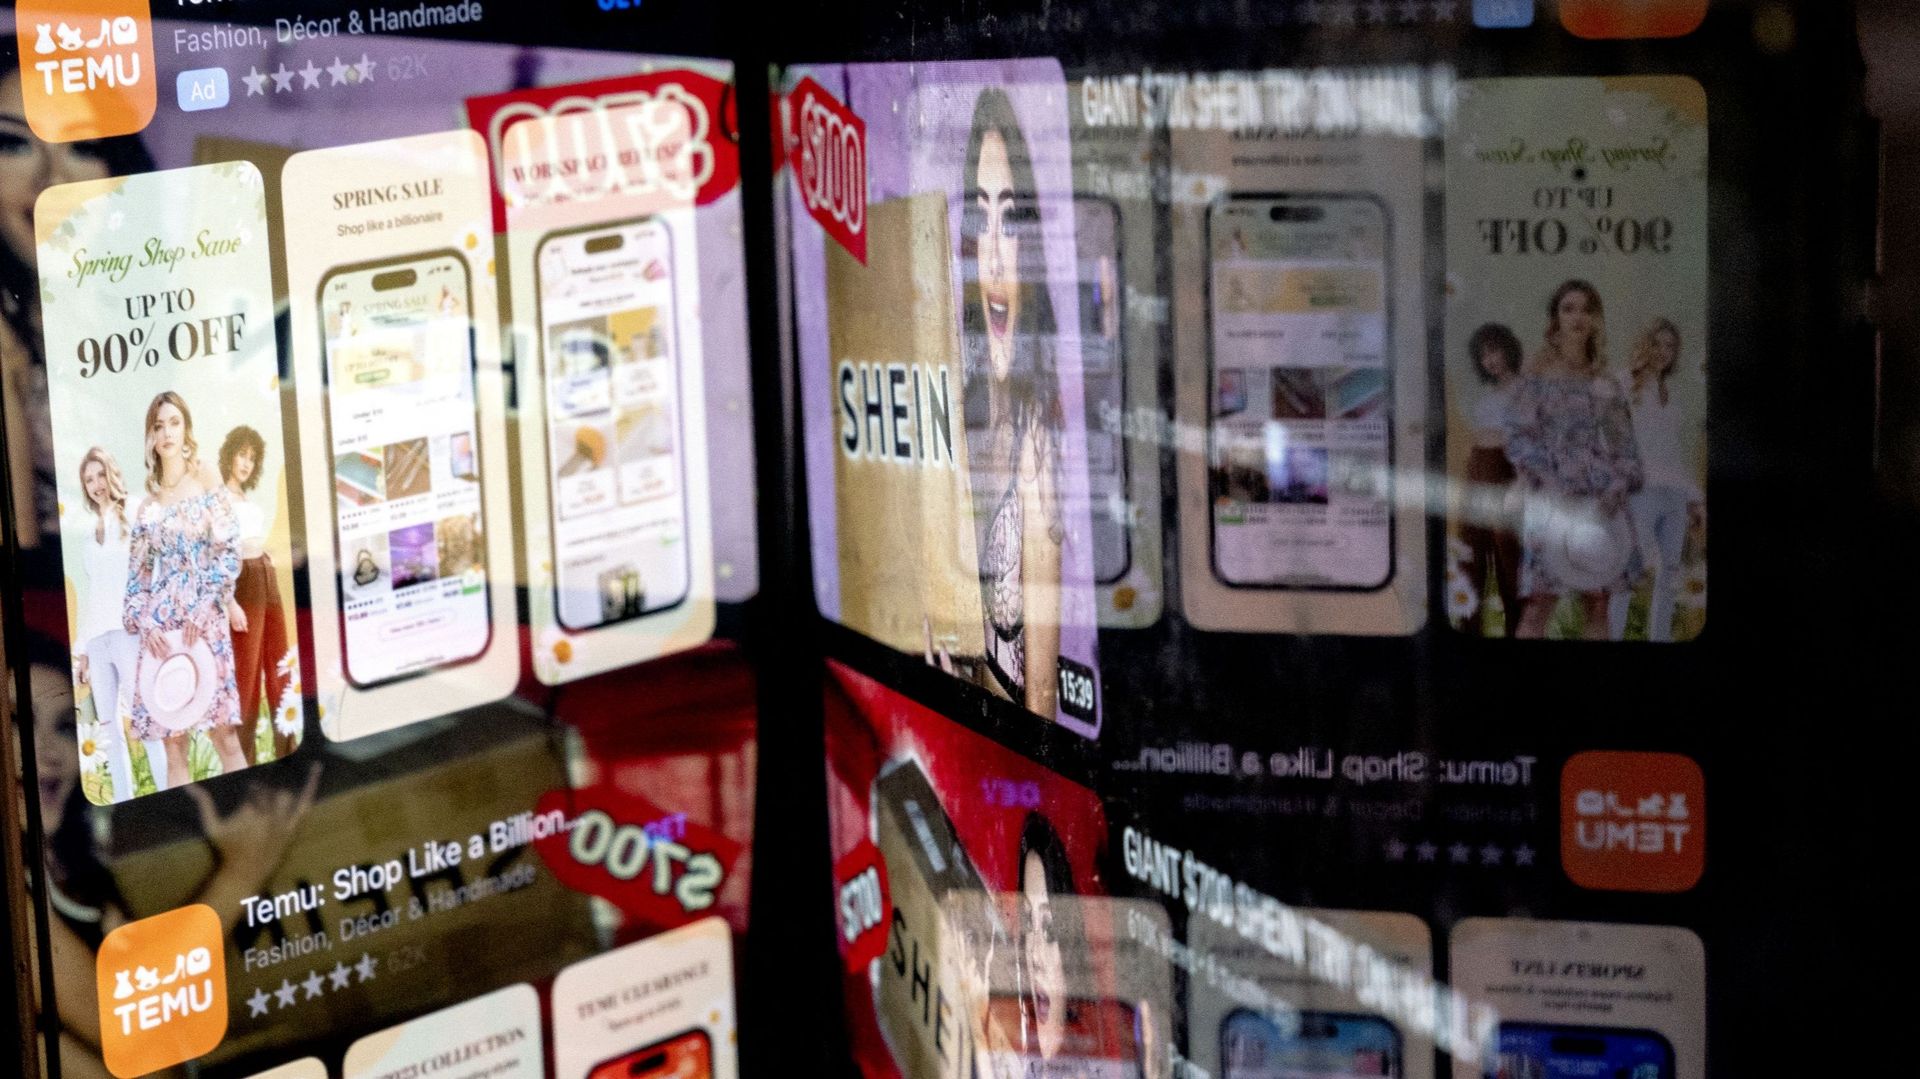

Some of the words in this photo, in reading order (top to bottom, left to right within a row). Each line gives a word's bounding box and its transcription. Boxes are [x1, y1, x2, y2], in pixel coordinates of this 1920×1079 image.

[173, 23, 268, 54] Fashion,
[276, 14, 341, 42] Décor
[348, 12, 364, 34] &
[370, 0, 482, 33] Handmade
[35, 52, 141, 96] TEMU
[190, 77, 217, 101] Ad
[332, 185, 398, 211] SPRING
[401, 178, 444, 200] SALE
[336, 223, 365, 237] Shop
[366, 217, 385, 232] like
[387, 220, 393, 229] a
[394, 211, 443, 228] billionaire
[66, 247, 132, 288] Spring
[138, 236, 186, 274] Shop
[191, 229, 242, 260] Save
[124, 294, 156, 321] UP
[160, 287, 195, 313] TO
[76, 321, 160, 380] 90%
[167, 312, 247, 363] OFF
[838, 359, 956, 467] SHEIN
[1059, 667, 1094, 711] 15:39
[239, 881, 326, 928] Temu:
[333, 858, 404, 902] Shop
[408, 838, 462, 880] Like
[468, 835, 485, 859] a
[1122, 826, 1181, 899] GIANT
[243, 926, 333, 973] Fashion,
[339, 908, 401, 943] Décor
[407, 896, 422, 922] &
[426, 863, 537, 916] Handmade
[113, 978, 213, 1037] TEMU
